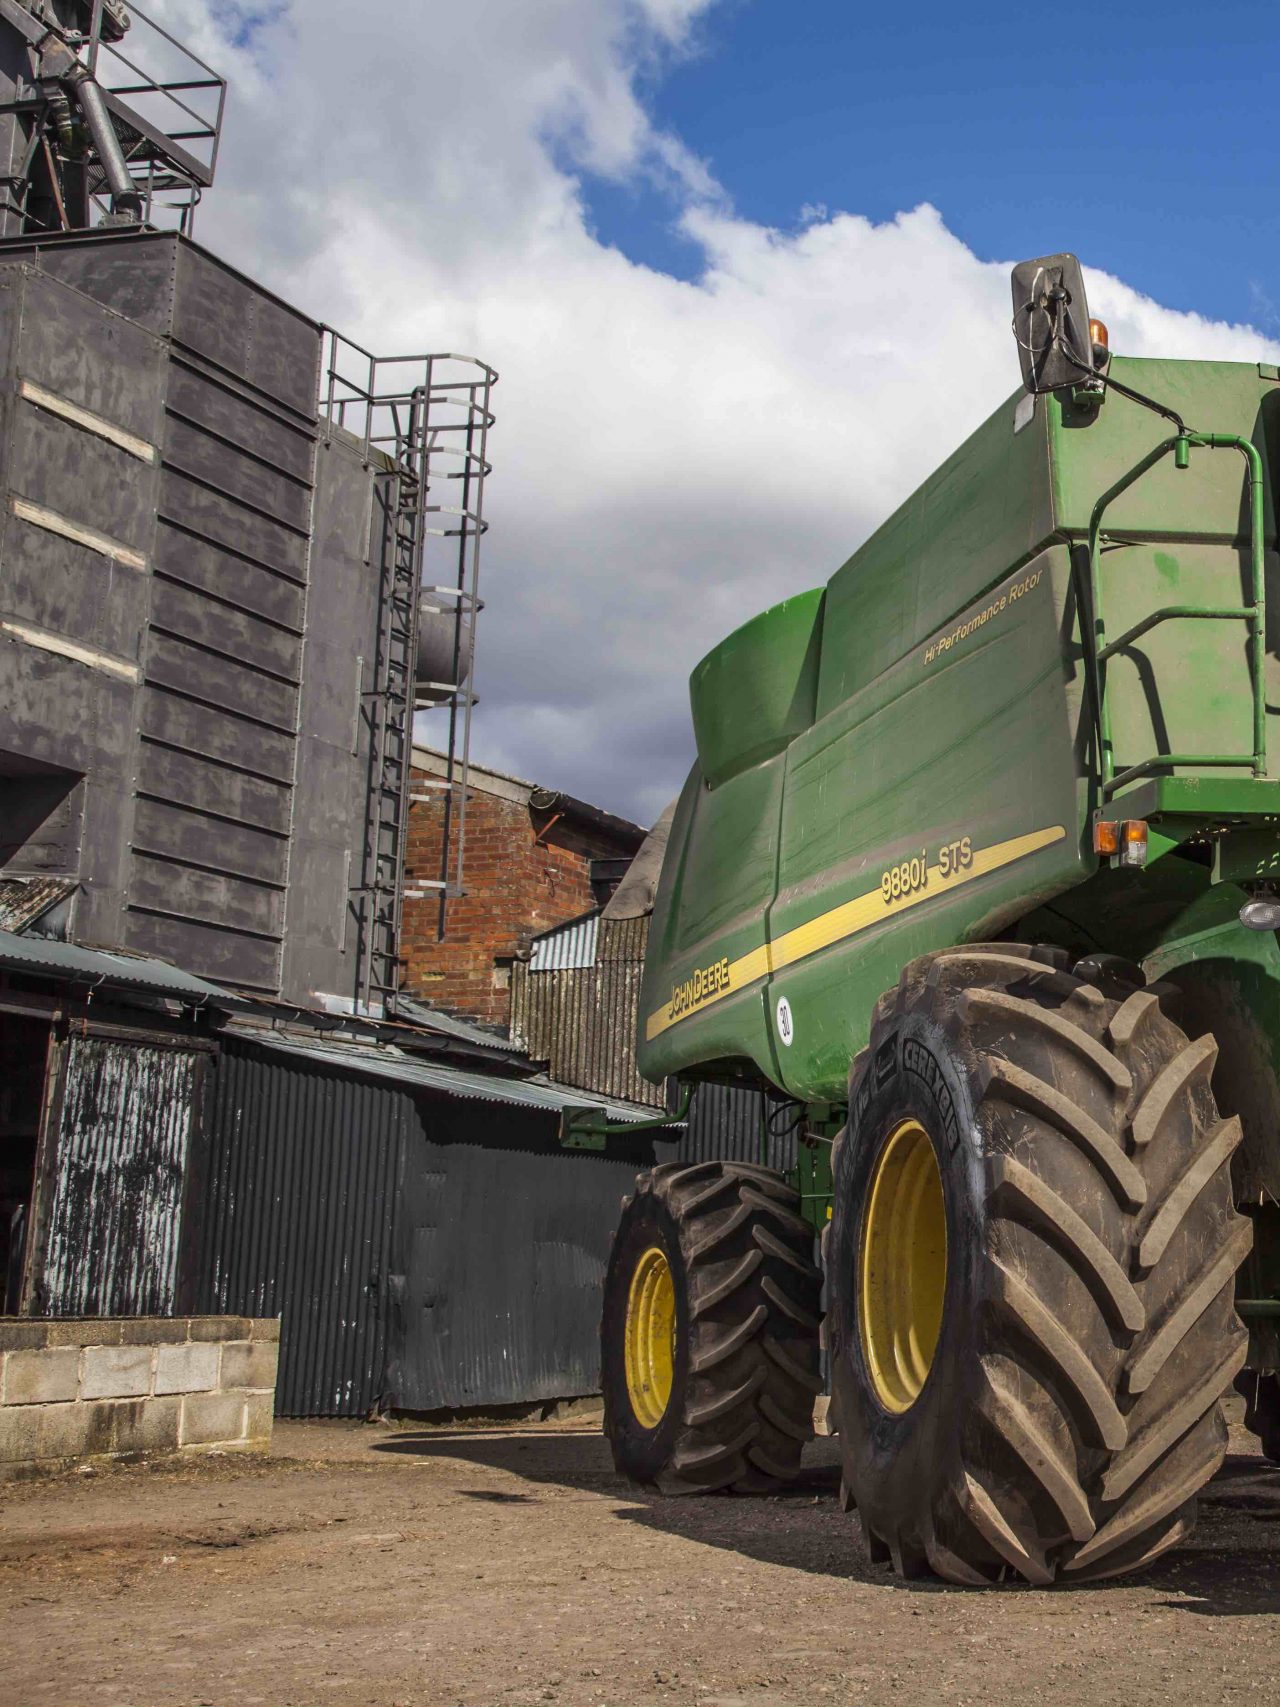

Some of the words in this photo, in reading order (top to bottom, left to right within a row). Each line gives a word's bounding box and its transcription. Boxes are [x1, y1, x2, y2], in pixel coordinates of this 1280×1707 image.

[923, 596, 1007, 665] Hi-Performance
[1008, 569, 1043, 604] Rotor
[881, 848, 927, 904] 9880i
[939, 836, 973, 877] STS
[668, 979, 694, 1020] JOHN
[693, 956, 731, 1003] DEERE
[780, 1005, 791, 1037] 30
